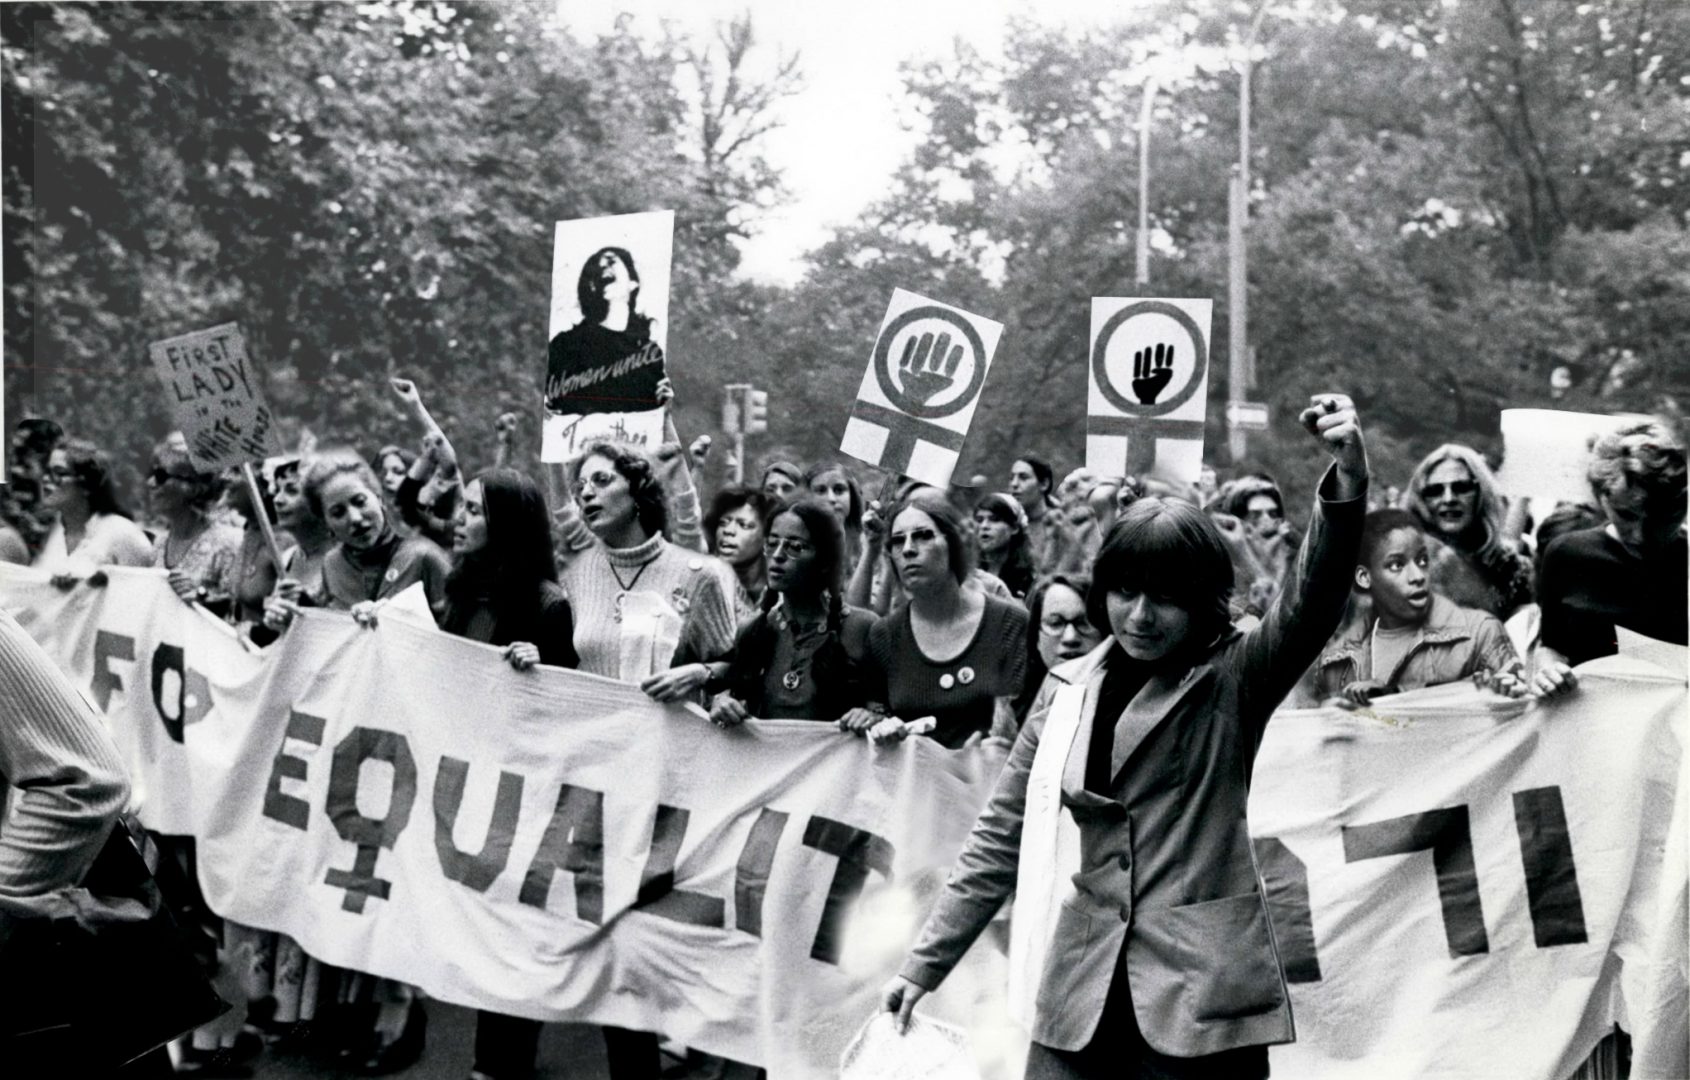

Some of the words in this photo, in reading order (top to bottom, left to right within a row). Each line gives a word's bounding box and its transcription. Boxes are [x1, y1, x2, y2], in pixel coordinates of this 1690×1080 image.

[172, 358, 253, 402] LADY
[548, 370, 612, 399] Women
[612, 339, 663, 378] unite
[561, 414, 648, 454] Tther
[263, 710, 896, 967] EQUALIT
